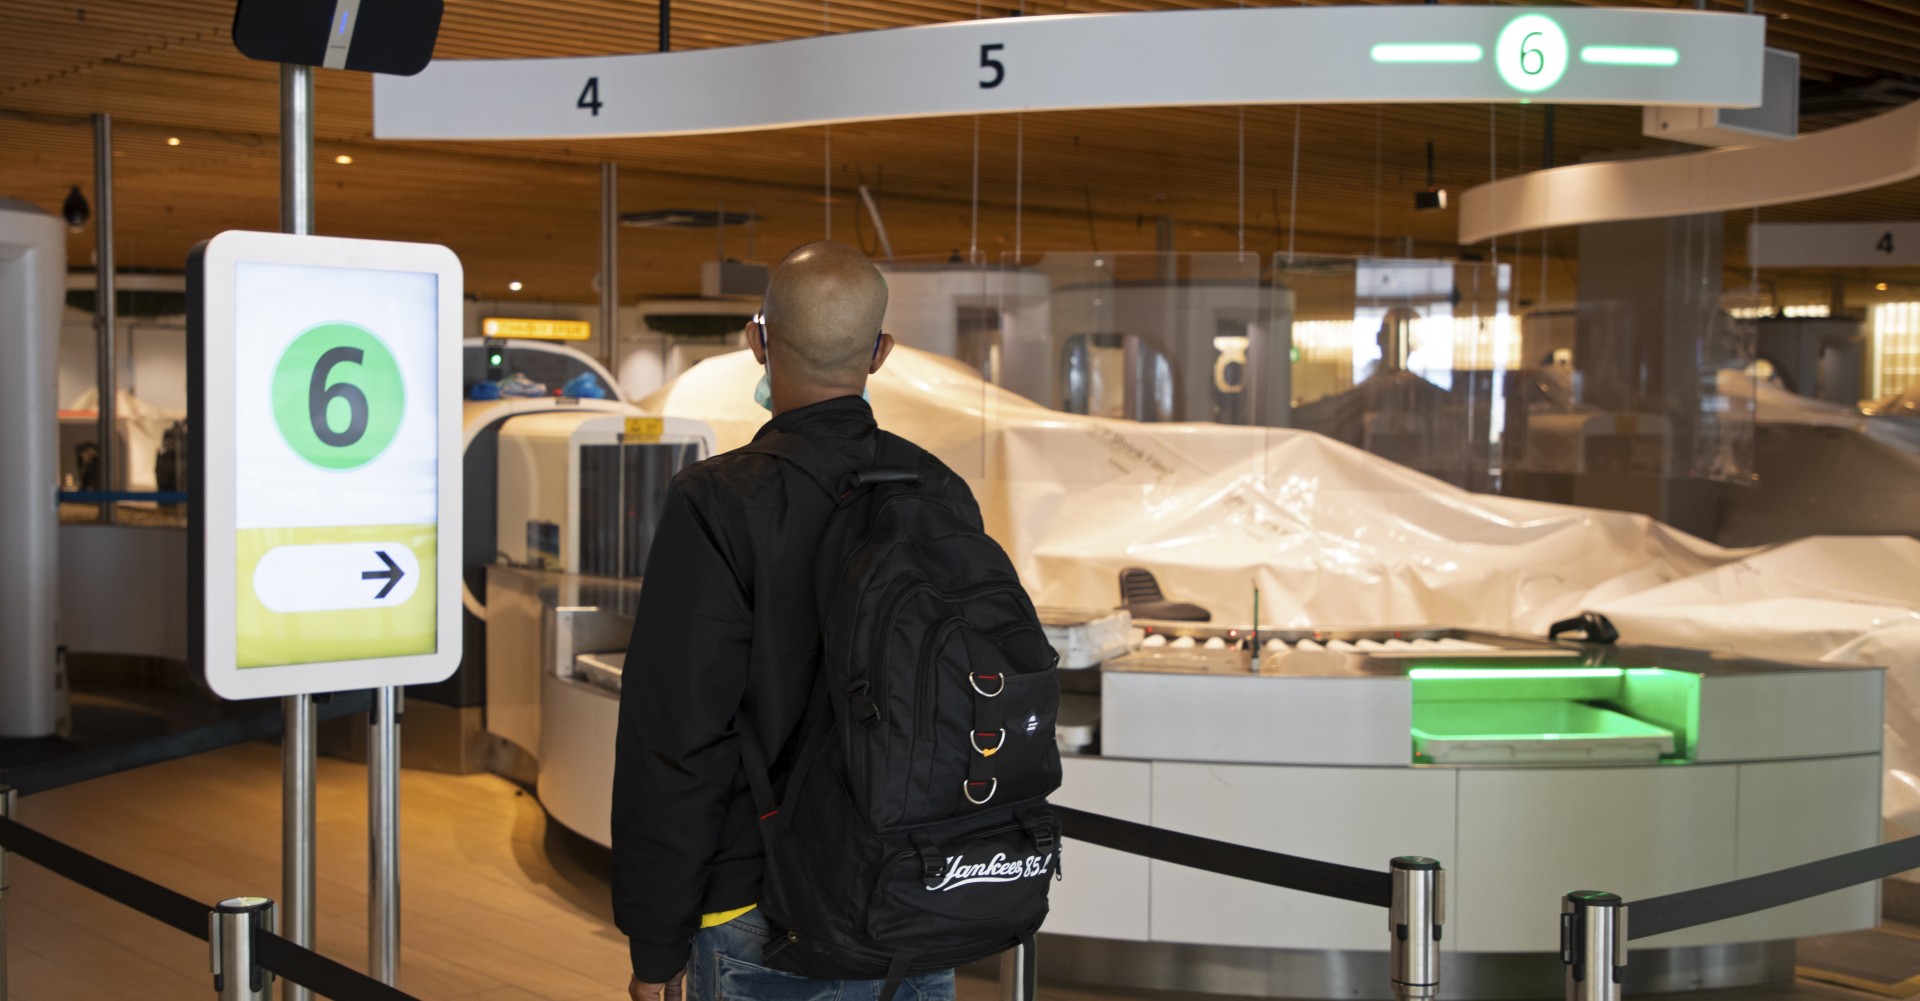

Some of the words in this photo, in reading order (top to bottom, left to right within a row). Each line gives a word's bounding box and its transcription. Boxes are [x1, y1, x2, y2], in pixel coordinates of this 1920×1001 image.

[979, 43, 1004, 89] 5
[1521, 31, 1544, 75] 6
[577, 77, 603, 116] 4
[1876, 232, 1894, 255] 4
[308, 346, 369, 448] 6
